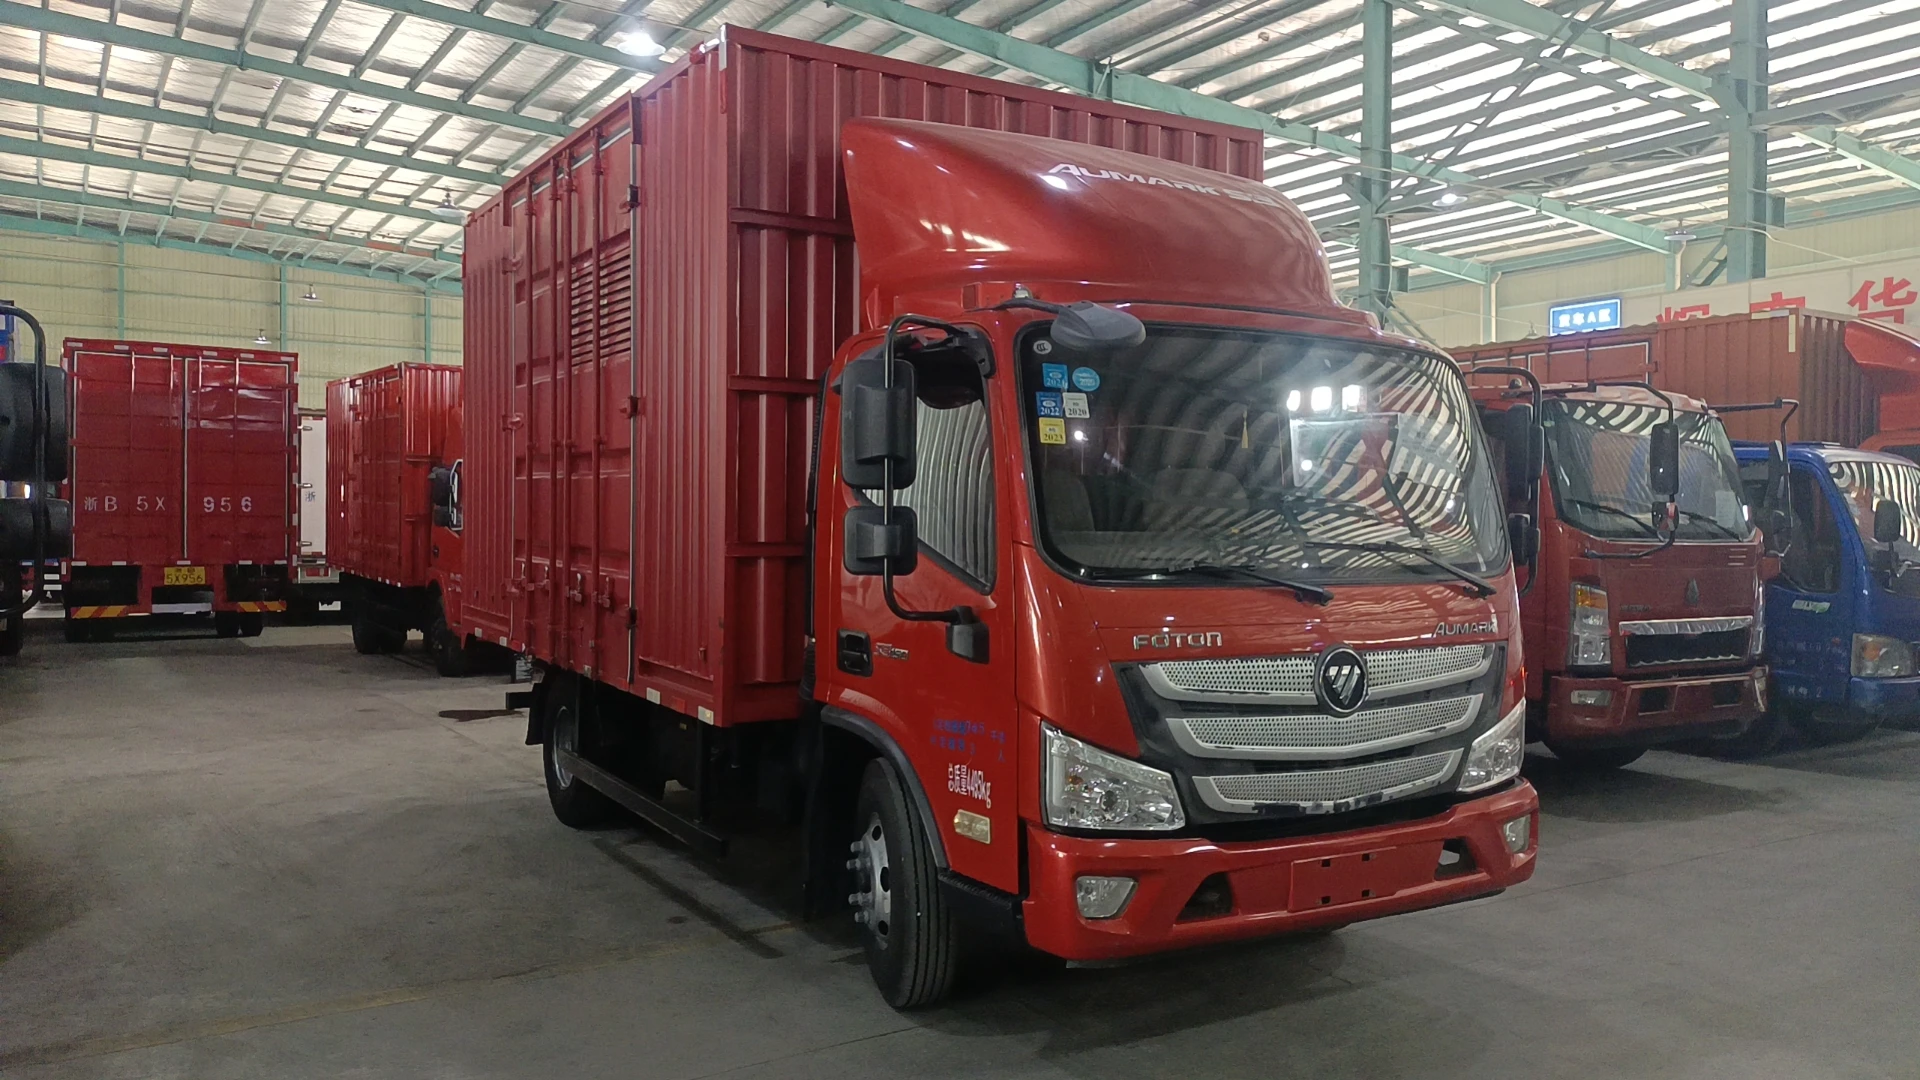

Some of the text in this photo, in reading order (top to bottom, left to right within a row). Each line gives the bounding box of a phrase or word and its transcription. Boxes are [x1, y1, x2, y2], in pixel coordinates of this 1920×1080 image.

[1048, 163, 1220, 196] AUMARK
[1040, 407, 1060, 416] 2022
[1068, 408, 1088, 417] 2020
[1044, 433, 1064, 441] 2023
[166, 573, 203, 583] 5X956
[1433, 621, 1498, 637] AUMARK
[1133, 632, 1223, 650] FOTON
